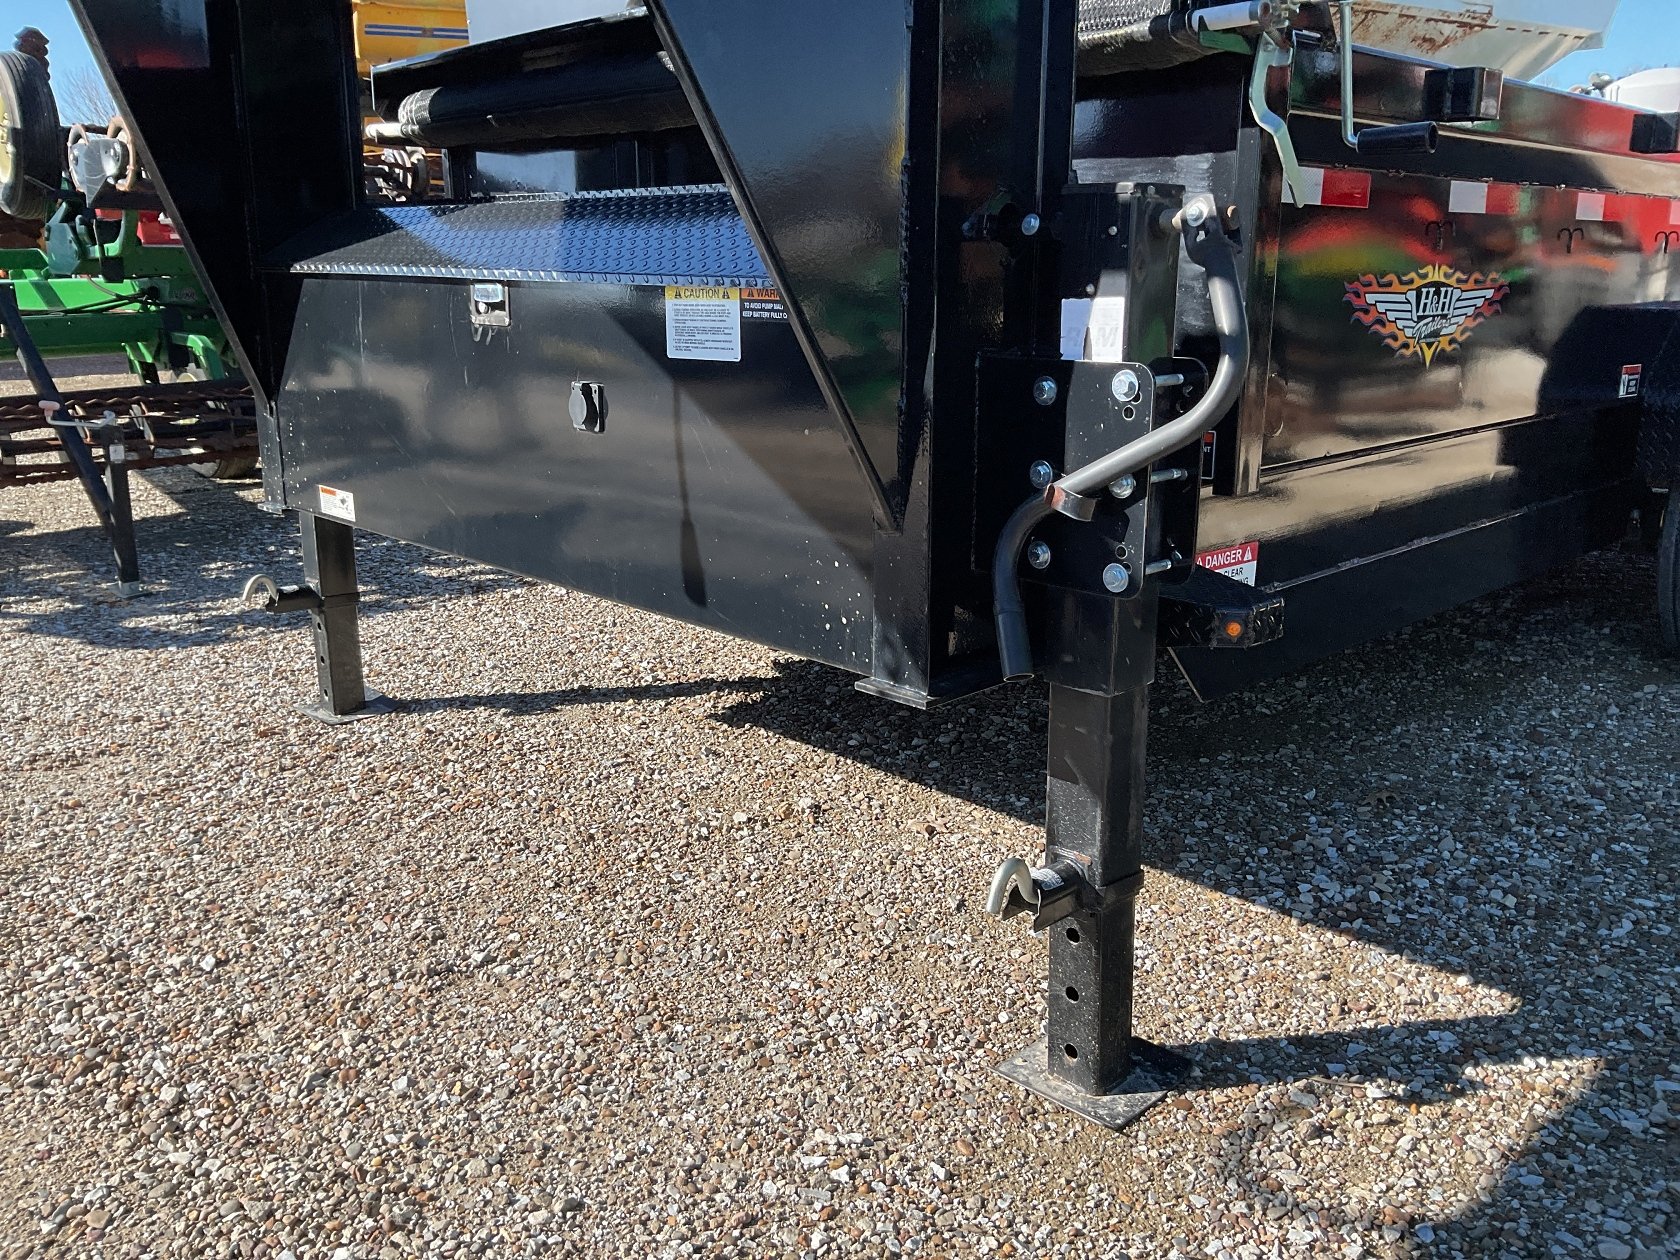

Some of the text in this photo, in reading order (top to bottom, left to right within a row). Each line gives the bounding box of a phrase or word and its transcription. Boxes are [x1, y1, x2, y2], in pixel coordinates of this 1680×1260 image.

[683, 288, 720, 299] CAUTION
[1417, 287, 1453, 316] H&H
[1205, 549, 1242, 569] DANGER
